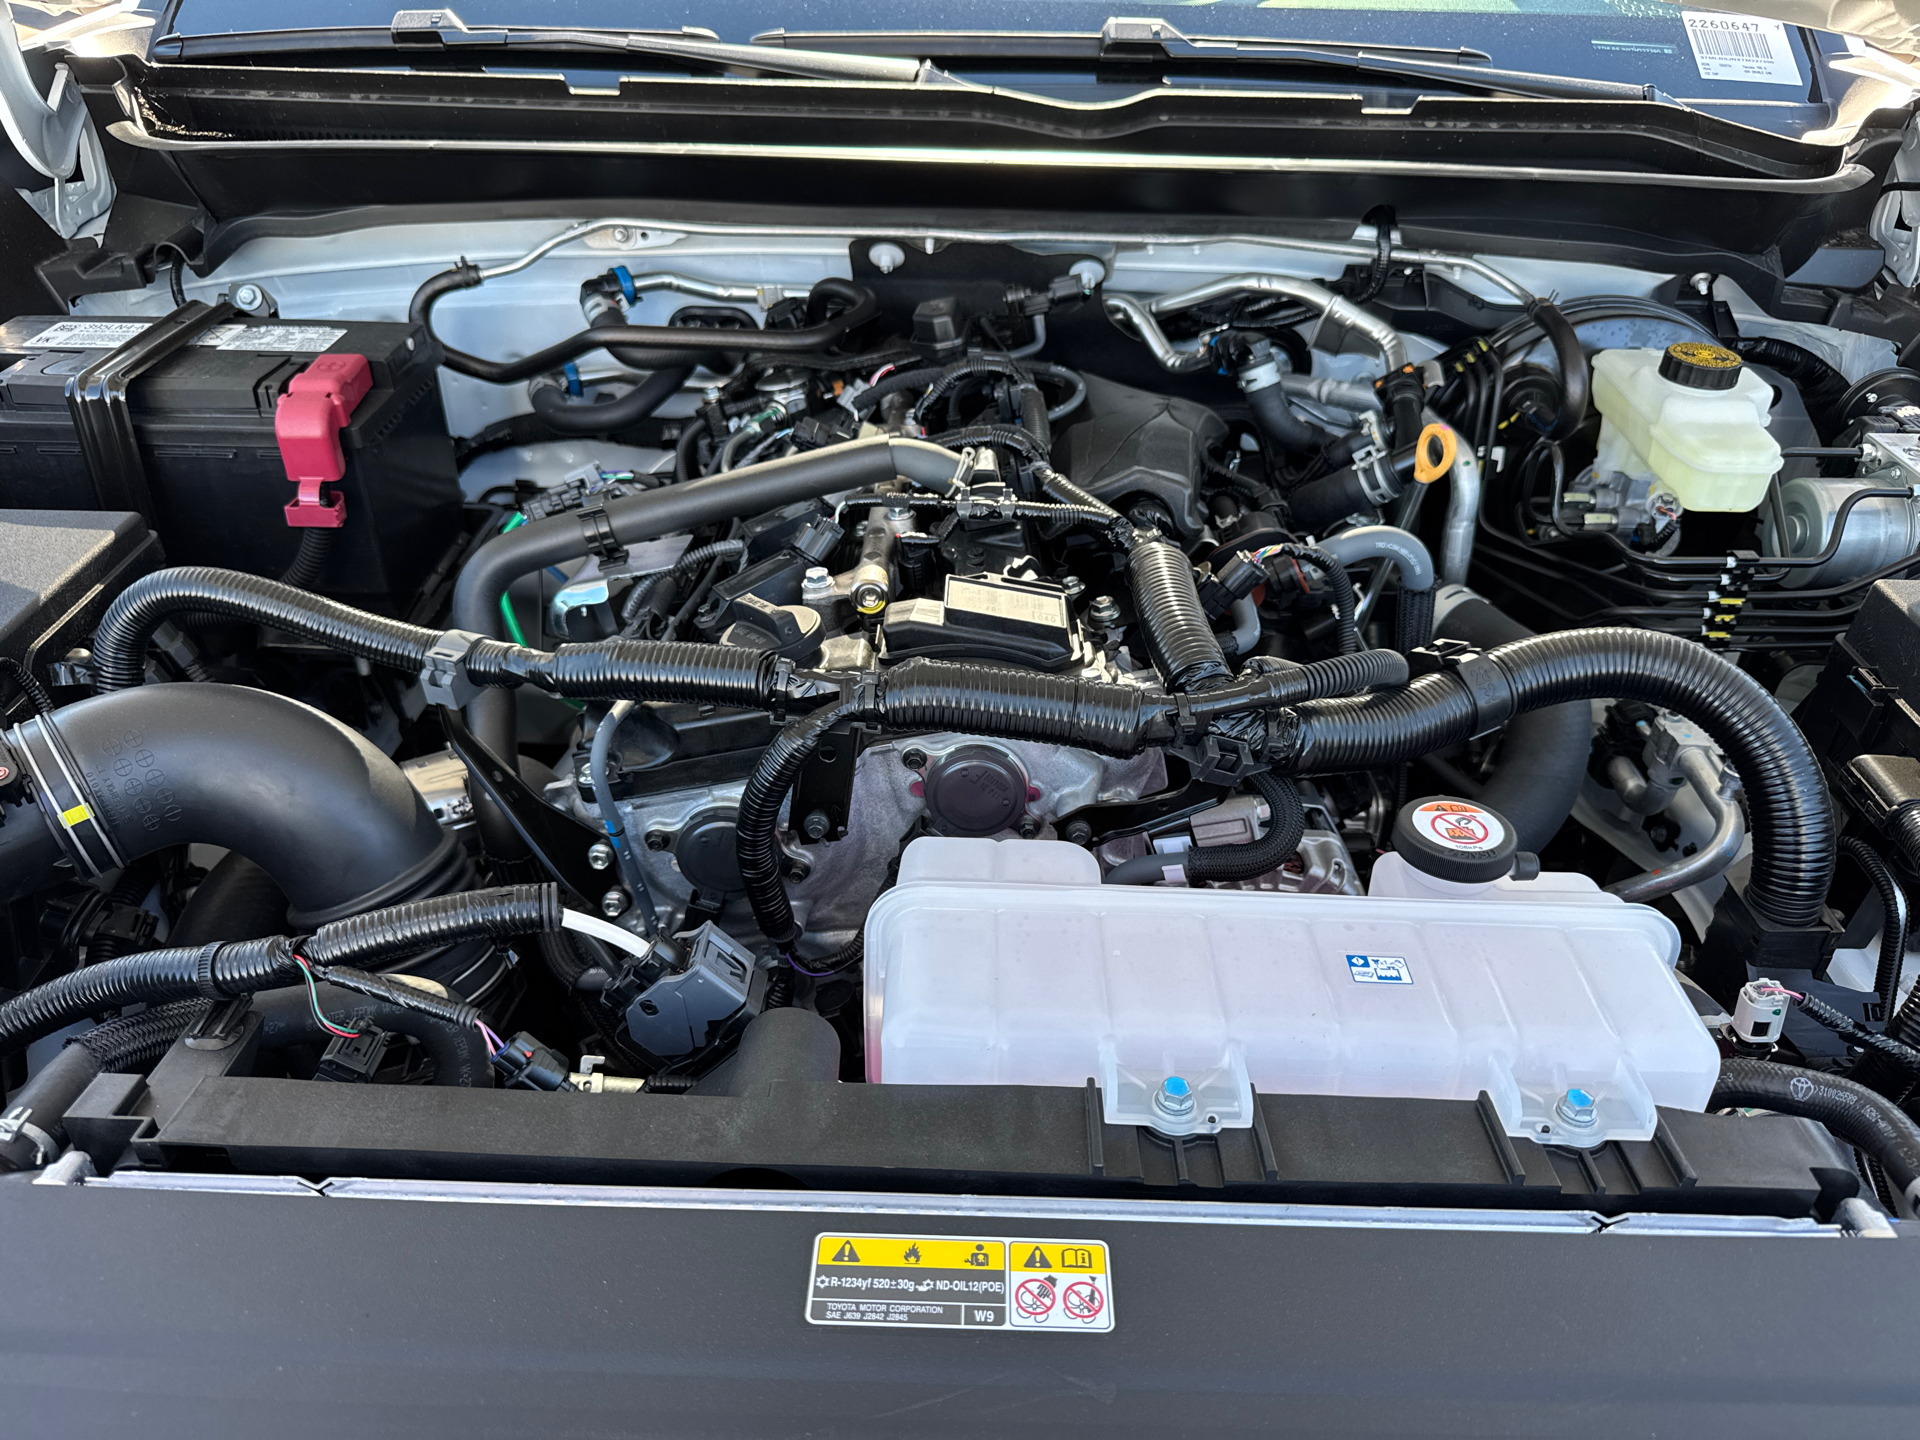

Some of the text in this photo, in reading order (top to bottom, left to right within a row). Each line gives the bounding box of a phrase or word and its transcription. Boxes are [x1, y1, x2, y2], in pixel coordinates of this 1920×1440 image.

[1688, 19, 1759, 32] 2260647
[831, 1276, 1004, 1294] R-1234yf 520±30g ND-OIL12(POE)
[859, 1304, 887, 1312] MOTOR
[889, 1305, 943, 1313] CORPORATION
[843, 1312, 861, 1320] J639
[863, 1312, 884, 1320] J2842
[886, 1313, 908, 1321] J2845
[974, 1310, 994, 1322] W9
